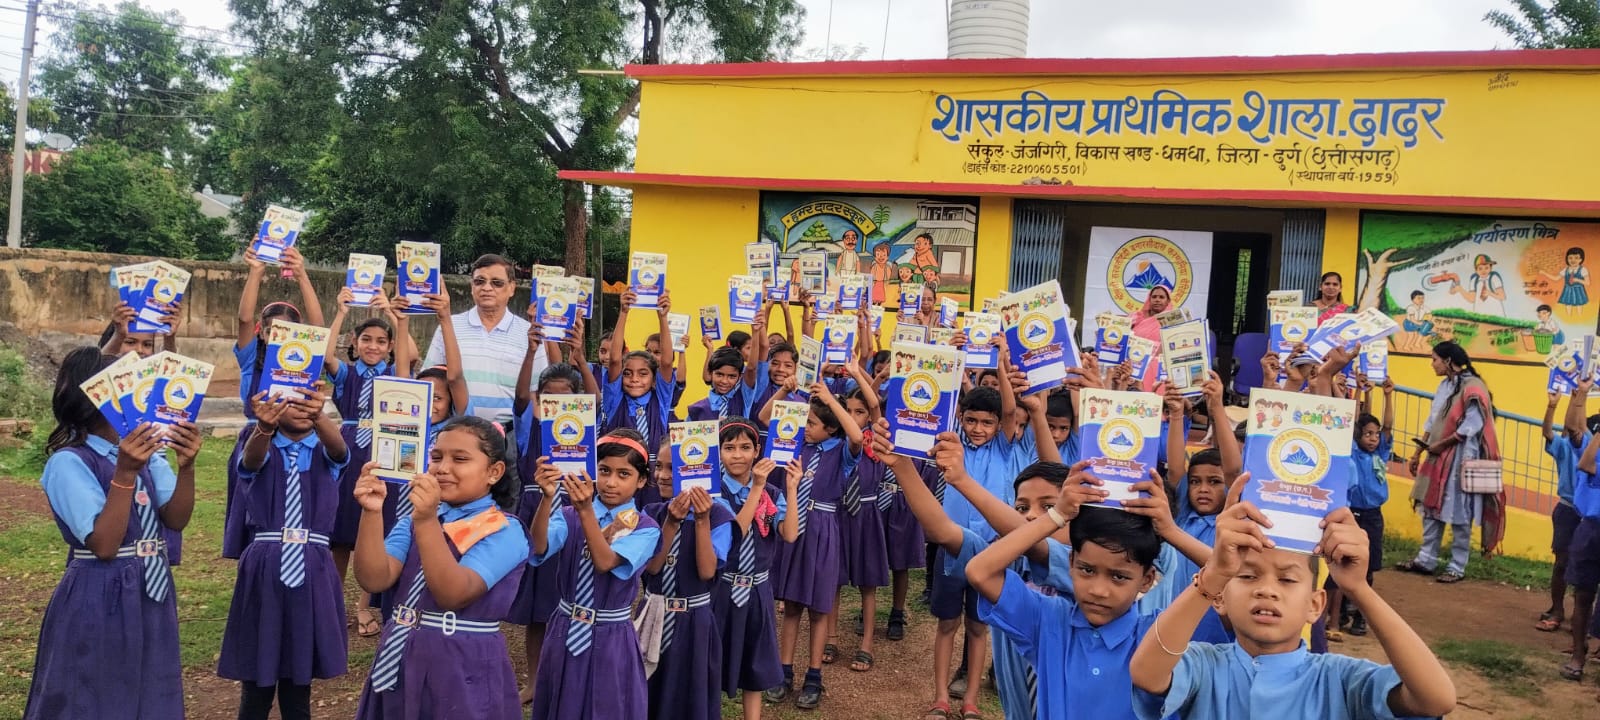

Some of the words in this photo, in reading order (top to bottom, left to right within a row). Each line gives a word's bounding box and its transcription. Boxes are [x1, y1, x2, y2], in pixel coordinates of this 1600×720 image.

[931, 90, 1085, 141] शासकीय
[1085, 89, 1232, 136] प्राथमिक
[1349, 98, 1445, 148] दादर
[1075, 141, 1121, 161] विकास
[1123, 147, 1153, 162] खण्ड
[1217, 143, 1261, 166] जिला
[1272, 142, 1302, 171] दुर्ग
[814, 203, 842, 213] दादर
[1532, 222, 1560, 240] मित्र
[1292, 409, 1352, 430] SCHOOL
